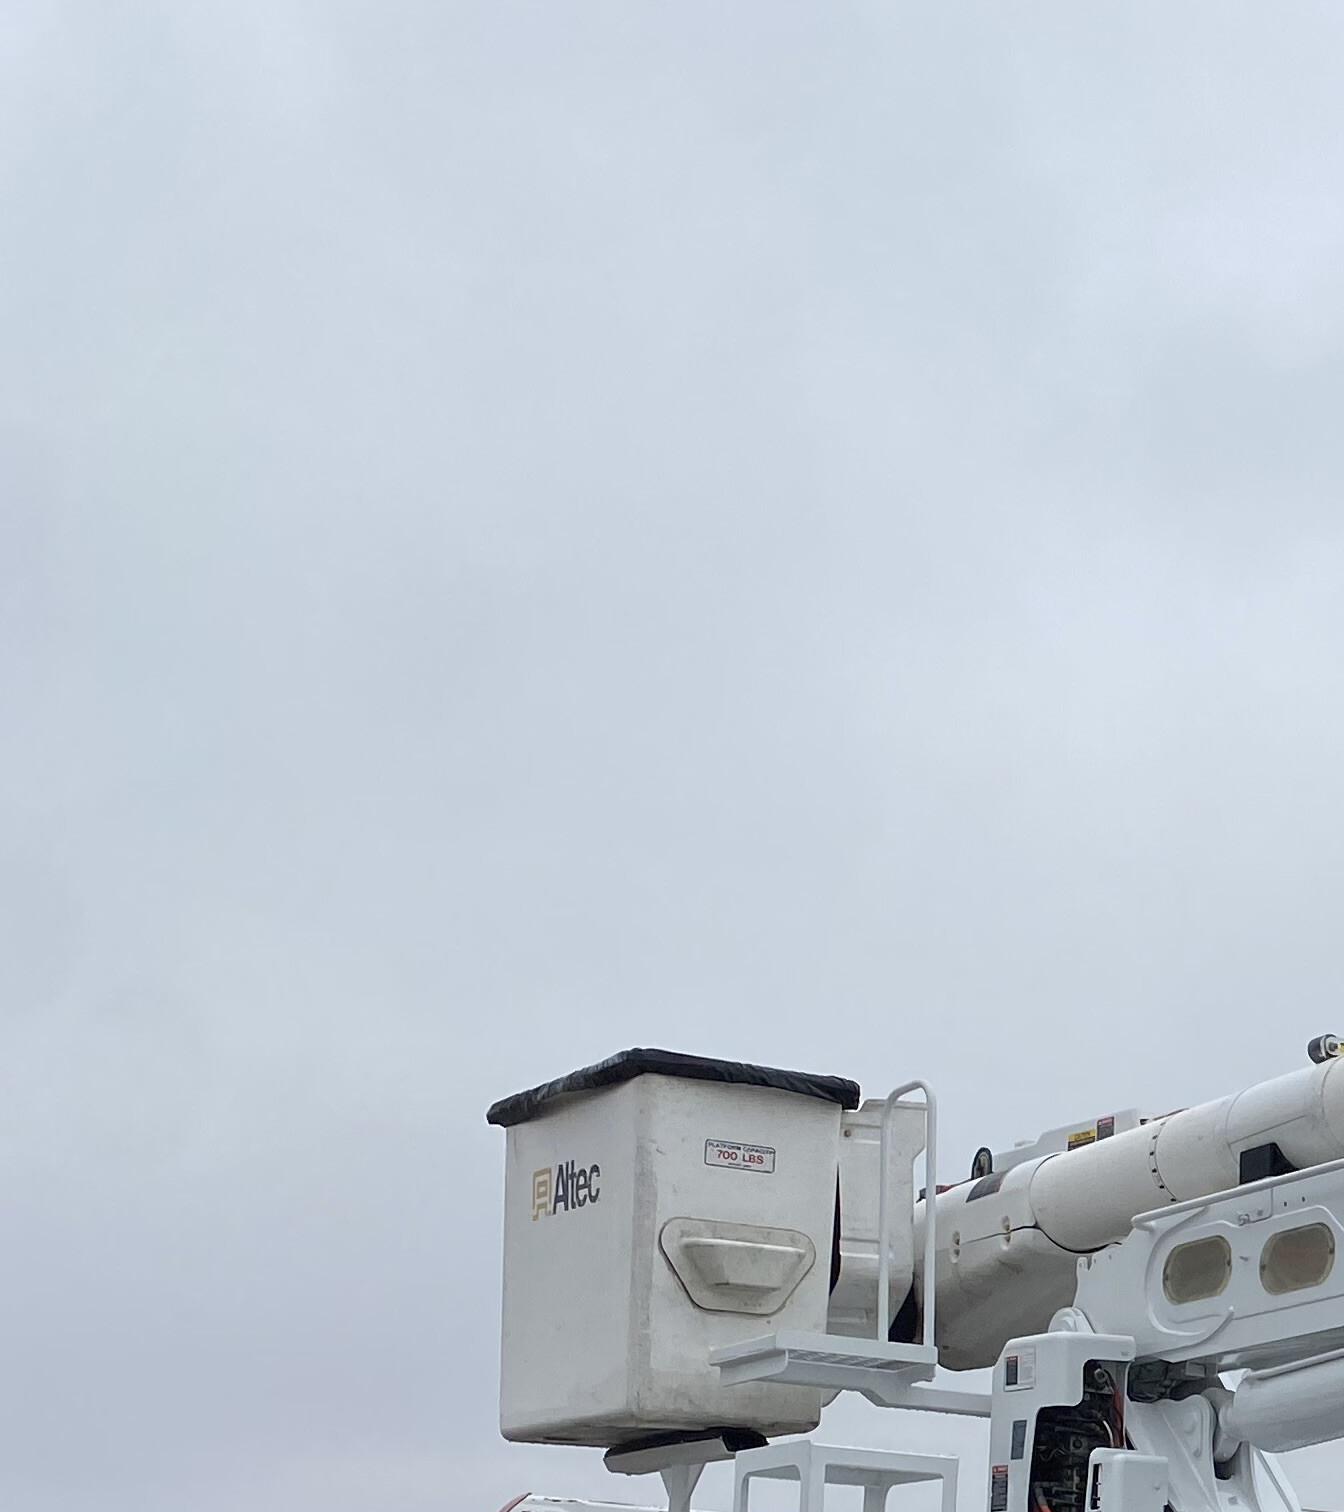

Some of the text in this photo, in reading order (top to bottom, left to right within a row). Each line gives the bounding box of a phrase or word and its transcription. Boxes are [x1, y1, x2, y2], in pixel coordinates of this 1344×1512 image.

[717, 1149, 764, 1164] 700 LBS
[553, 1160, 600, 1214] Altec
